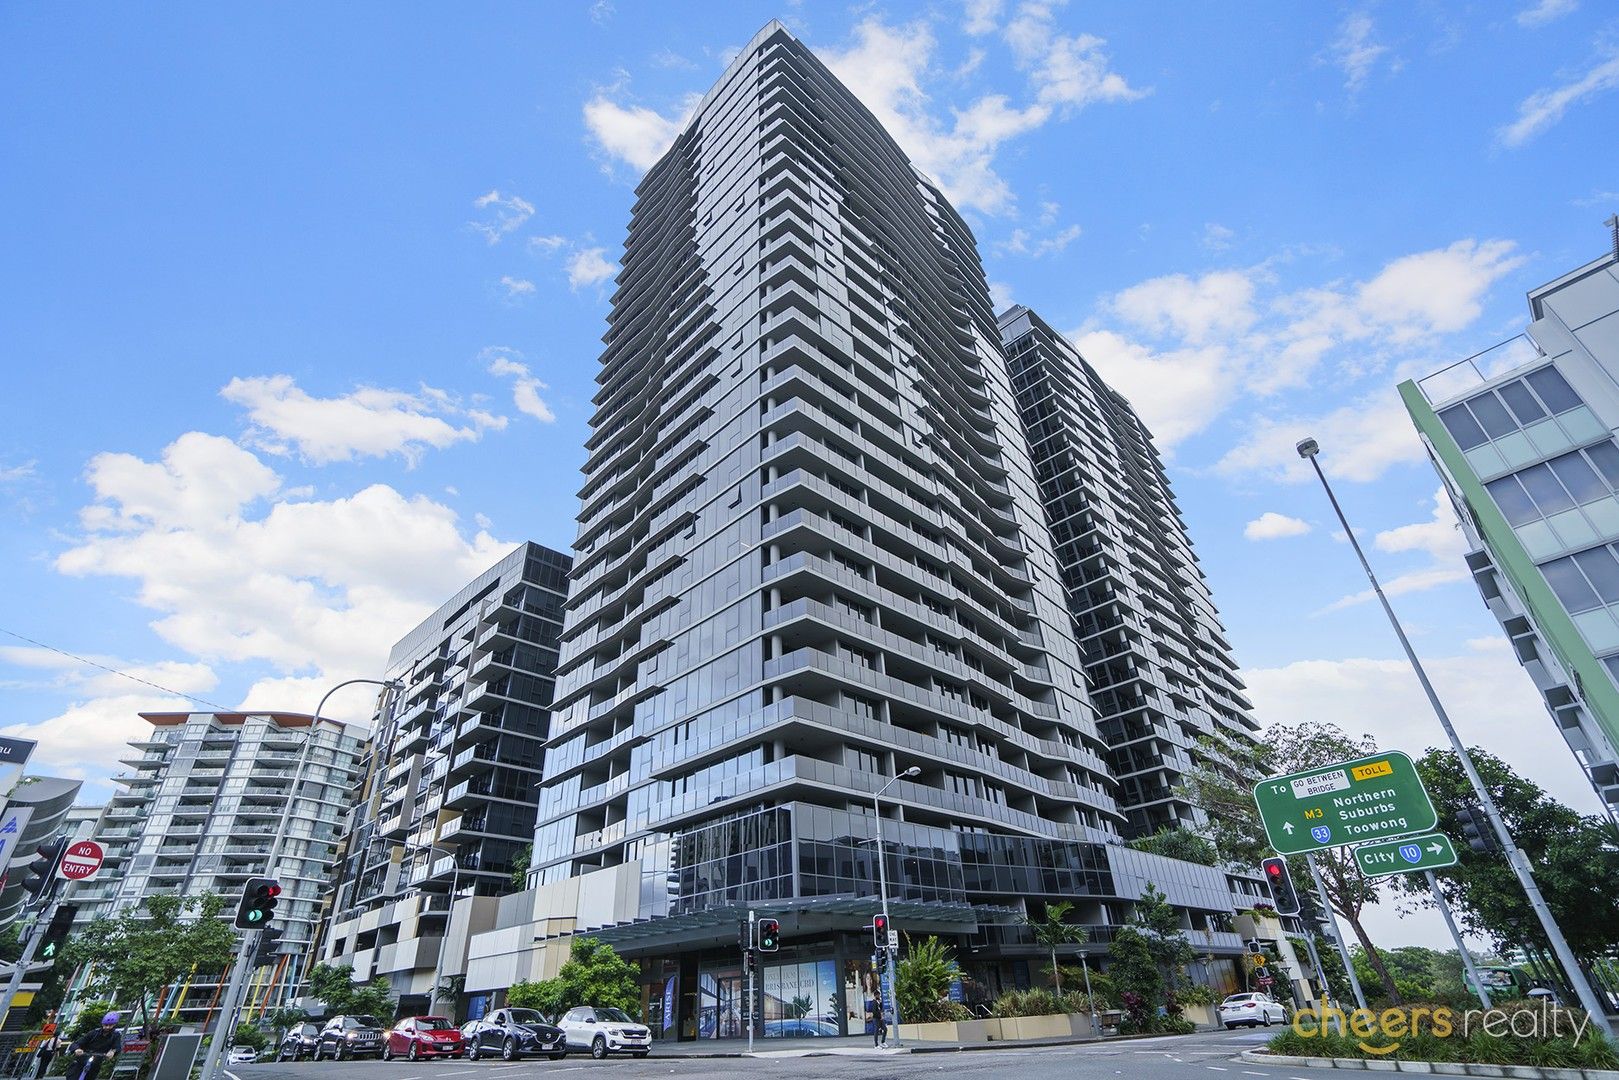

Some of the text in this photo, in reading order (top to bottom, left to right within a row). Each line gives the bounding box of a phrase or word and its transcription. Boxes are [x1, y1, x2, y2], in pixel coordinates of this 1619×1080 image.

[1358, 765, 1386, 777] TOLL
[1293, 771, 1343, 789] GO BETWEEN
[1270, 785, 1287, 796] To
[1307, 783, 1336, 795] BRIDGE
[1333, 788, 1397, 808] Northern
[1304, 808, 1324, 821] M3
[1339, 802, 1396, 821] Suburbs
[1344, 817, 1408, 836] Toowong
[1314, 828, 1329, 839] 33
[78, 847, 92, 856] NO
[1363, 848, 1418, 865] City 10
[63, 863, 93, 875] ENTRY
